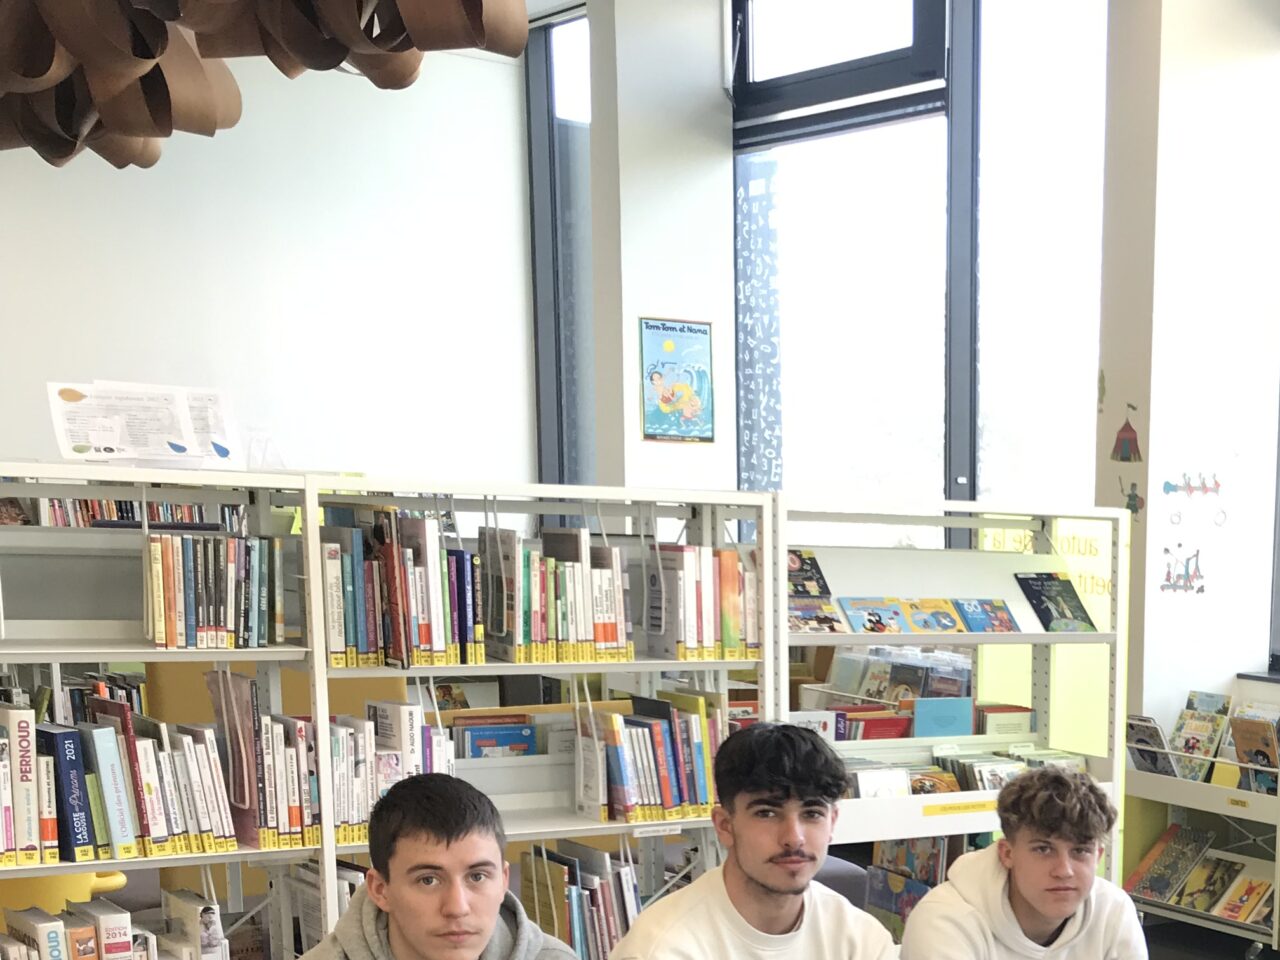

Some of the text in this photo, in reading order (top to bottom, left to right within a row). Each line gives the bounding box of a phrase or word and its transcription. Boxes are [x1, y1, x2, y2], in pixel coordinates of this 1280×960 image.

[644, 322, 708, 335] Tom-Tom et Nana
[18, 720, 32, 782] PERNOUD
[64, 739, 76, 761] 2021
[72, 812, 81, 833] COTE
[80, 812, 89, 843] LAROUSSE
[75, 834, 83, 844] LA
[105, 930, 128, 940] 2014
